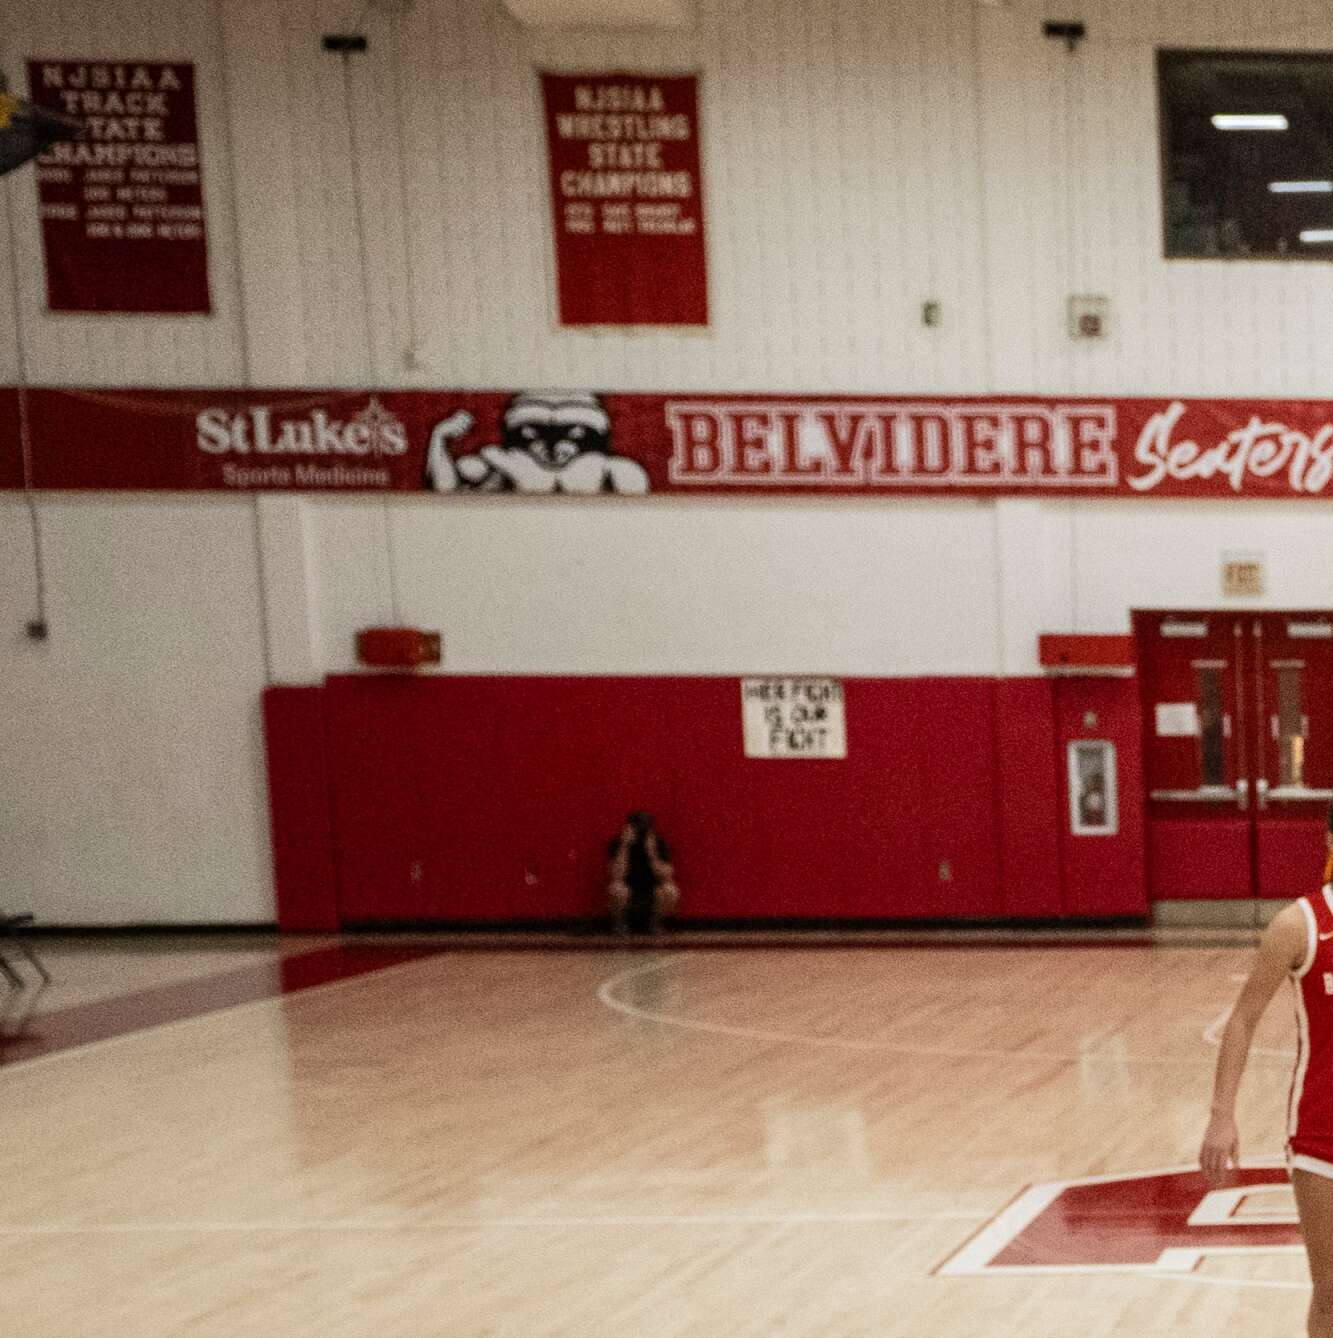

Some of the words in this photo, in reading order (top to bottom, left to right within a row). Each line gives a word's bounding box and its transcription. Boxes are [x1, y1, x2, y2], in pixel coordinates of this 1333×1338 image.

[59, 90, 169, 116] TRACK
[84, 116, 165, 142] TATE
[556, 112, 690, 141] WRESTLING
[588, 141, 664, 169] STATE
[560, 169, 693, 199] CHAMPIONS
[666, 402, 1118, 488] BELVIDERE
